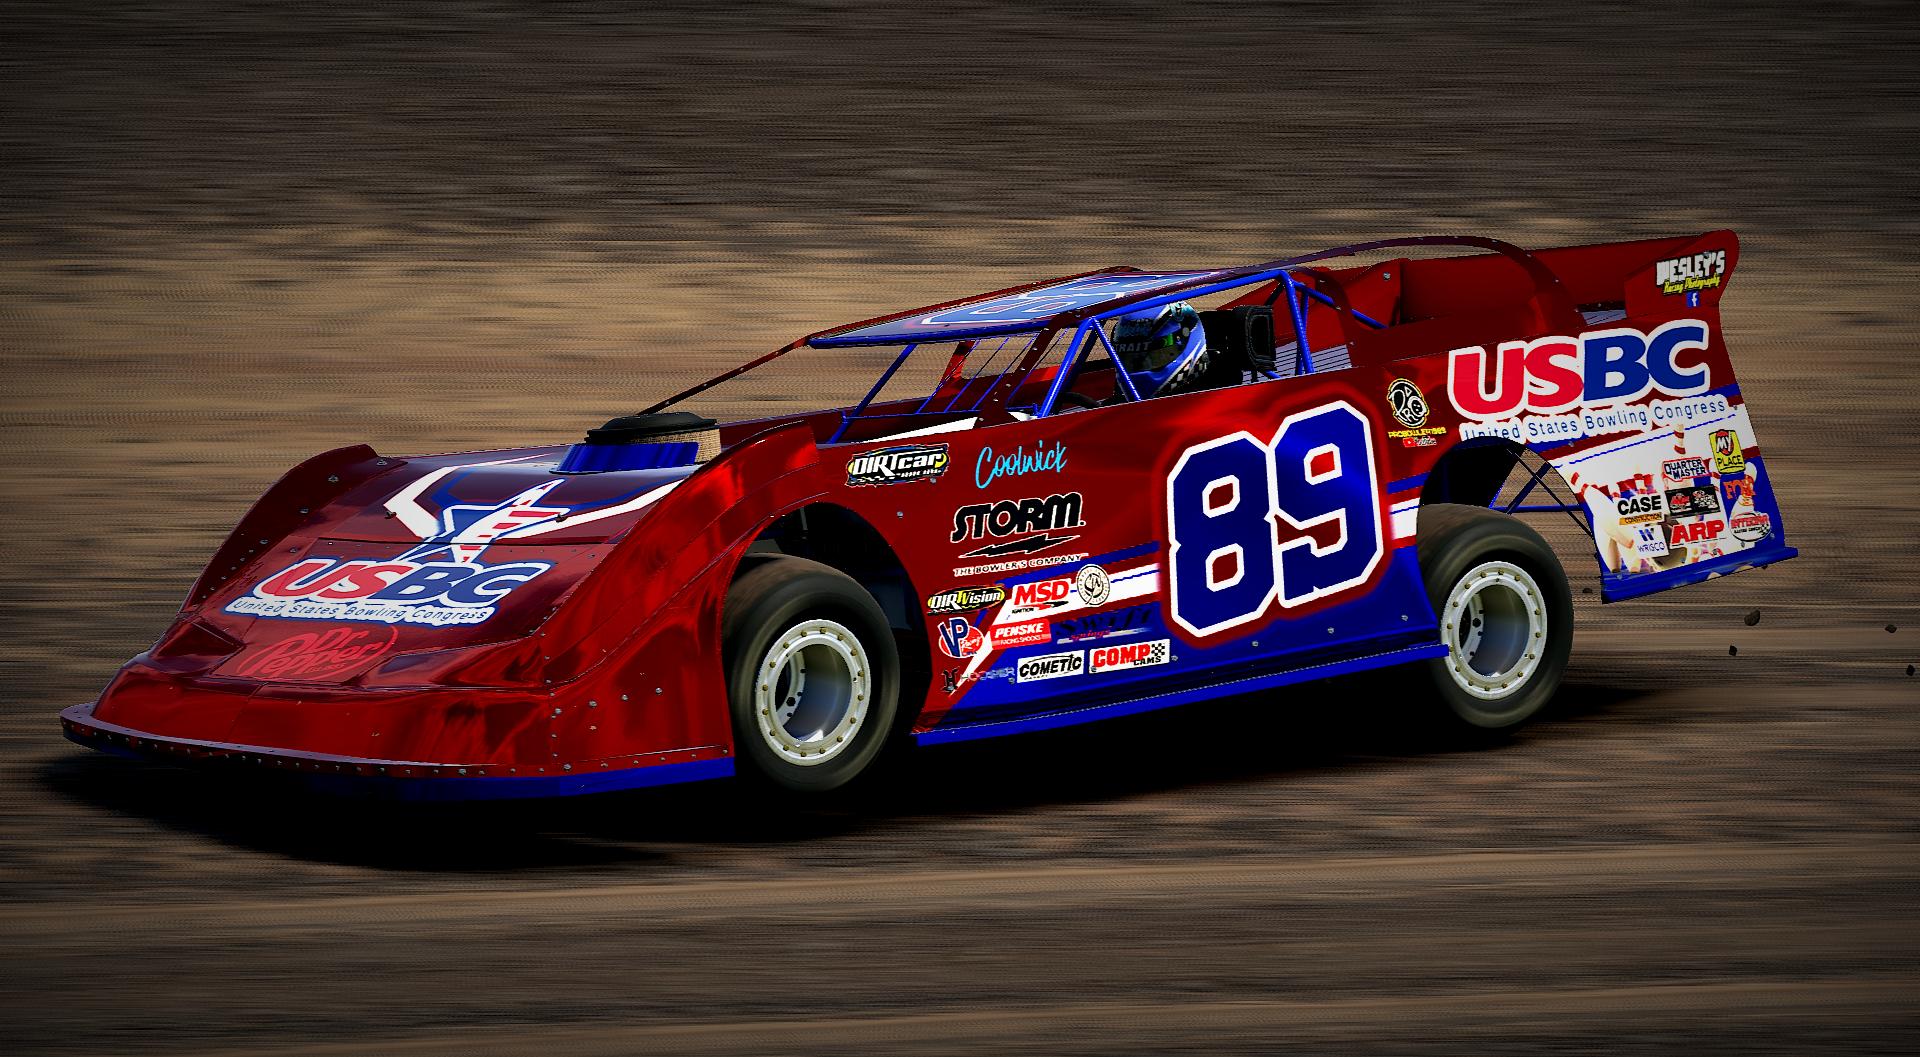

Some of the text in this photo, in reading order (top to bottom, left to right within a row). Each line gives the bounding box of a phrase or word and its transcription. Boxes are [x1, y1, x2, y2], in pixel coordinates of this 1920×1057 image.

[1656, 250, 1725, 285] WESLEY'S
[1450, 322, 1708, 418] USBC
[1528, 418, 1578, 436] States
[1585, 409, 1648, 430] Bowling
[1653, 398, 1726, 420] Congress
[1716, 431, 1732, 453] MY
[852, 453, 942, 477] DIRTcar
[1664, 459, 1703, 475] QUARTER
[1717, 455, 1743, 466] PLACE
[1673, 467, 1706, 479] MASTER
[1617, 495, 1662, 515] CASE
[1167, 400, 1384, 637] 89
[1672, 519, 1724, 544] ARP
[954, 567, 974, 576] THE
[1029, 554, 1082, 567] COMPANY
[255, 560, 549, 605] USBC
[1014, 581, 1069, 605] MSD
[233, 600, 488, 621] United States Bowling Congress
[938, 617, 968, 658] VP
[995, 622, 1045, 639] PENSKE
[1019, 655, 1082, 678] COMETIC
[1093, 644, 1151, 668] COMP
[1133, 655, 1162, 666] CAMS
